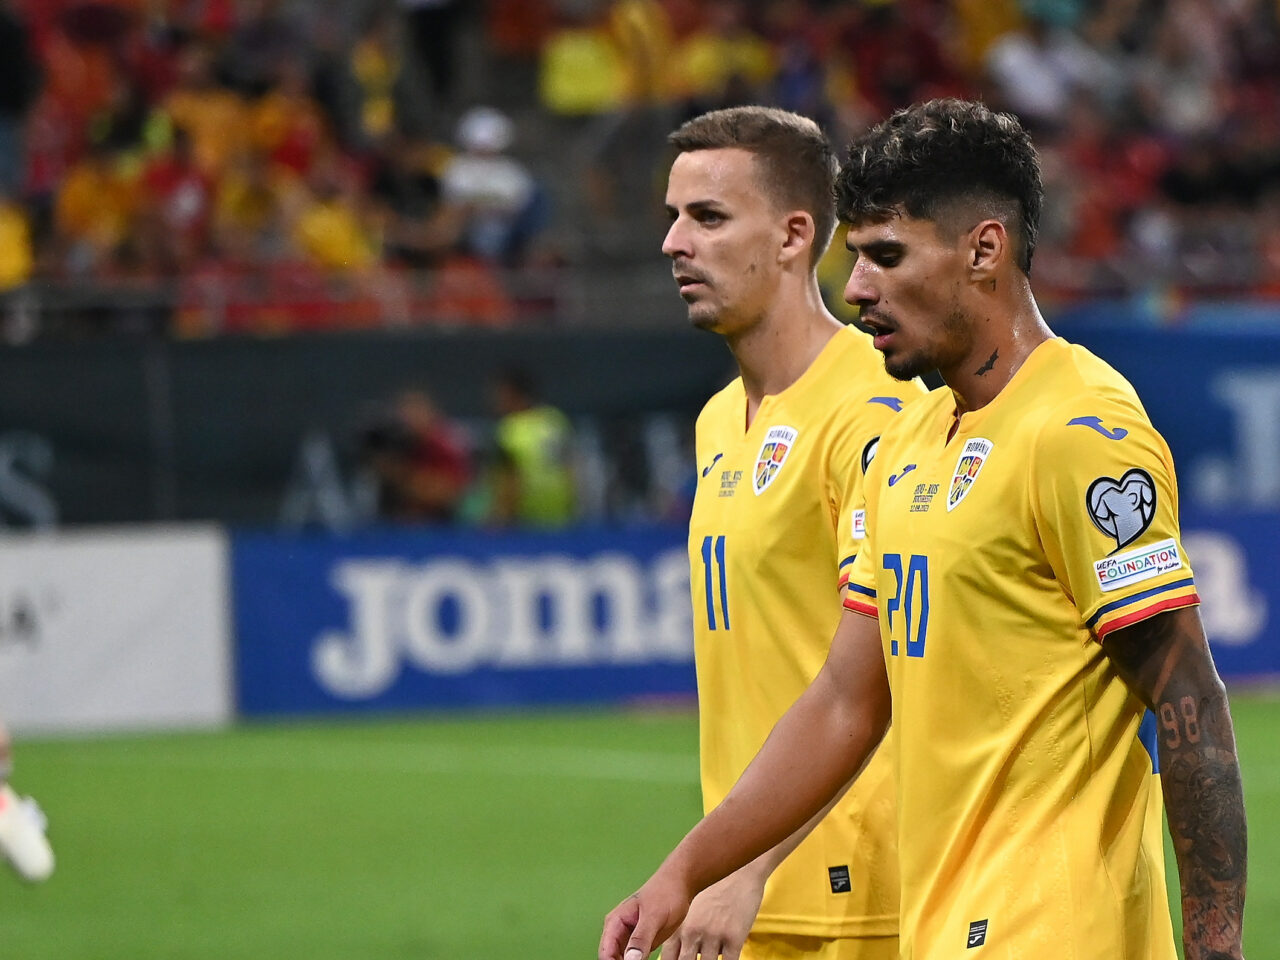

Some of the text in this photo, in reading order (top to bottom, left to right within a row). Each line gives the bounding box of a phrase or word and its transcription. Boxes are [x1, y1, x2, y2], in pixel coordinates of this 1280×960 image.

[701, 535, 730, 631] 11
[1096, 559, 1117, 570] UEFA
[1098, 548, 1178, 581] FOUNDATION
[882, 553, 930, 658] 20
[1160, 695, 1201, 750] 98
